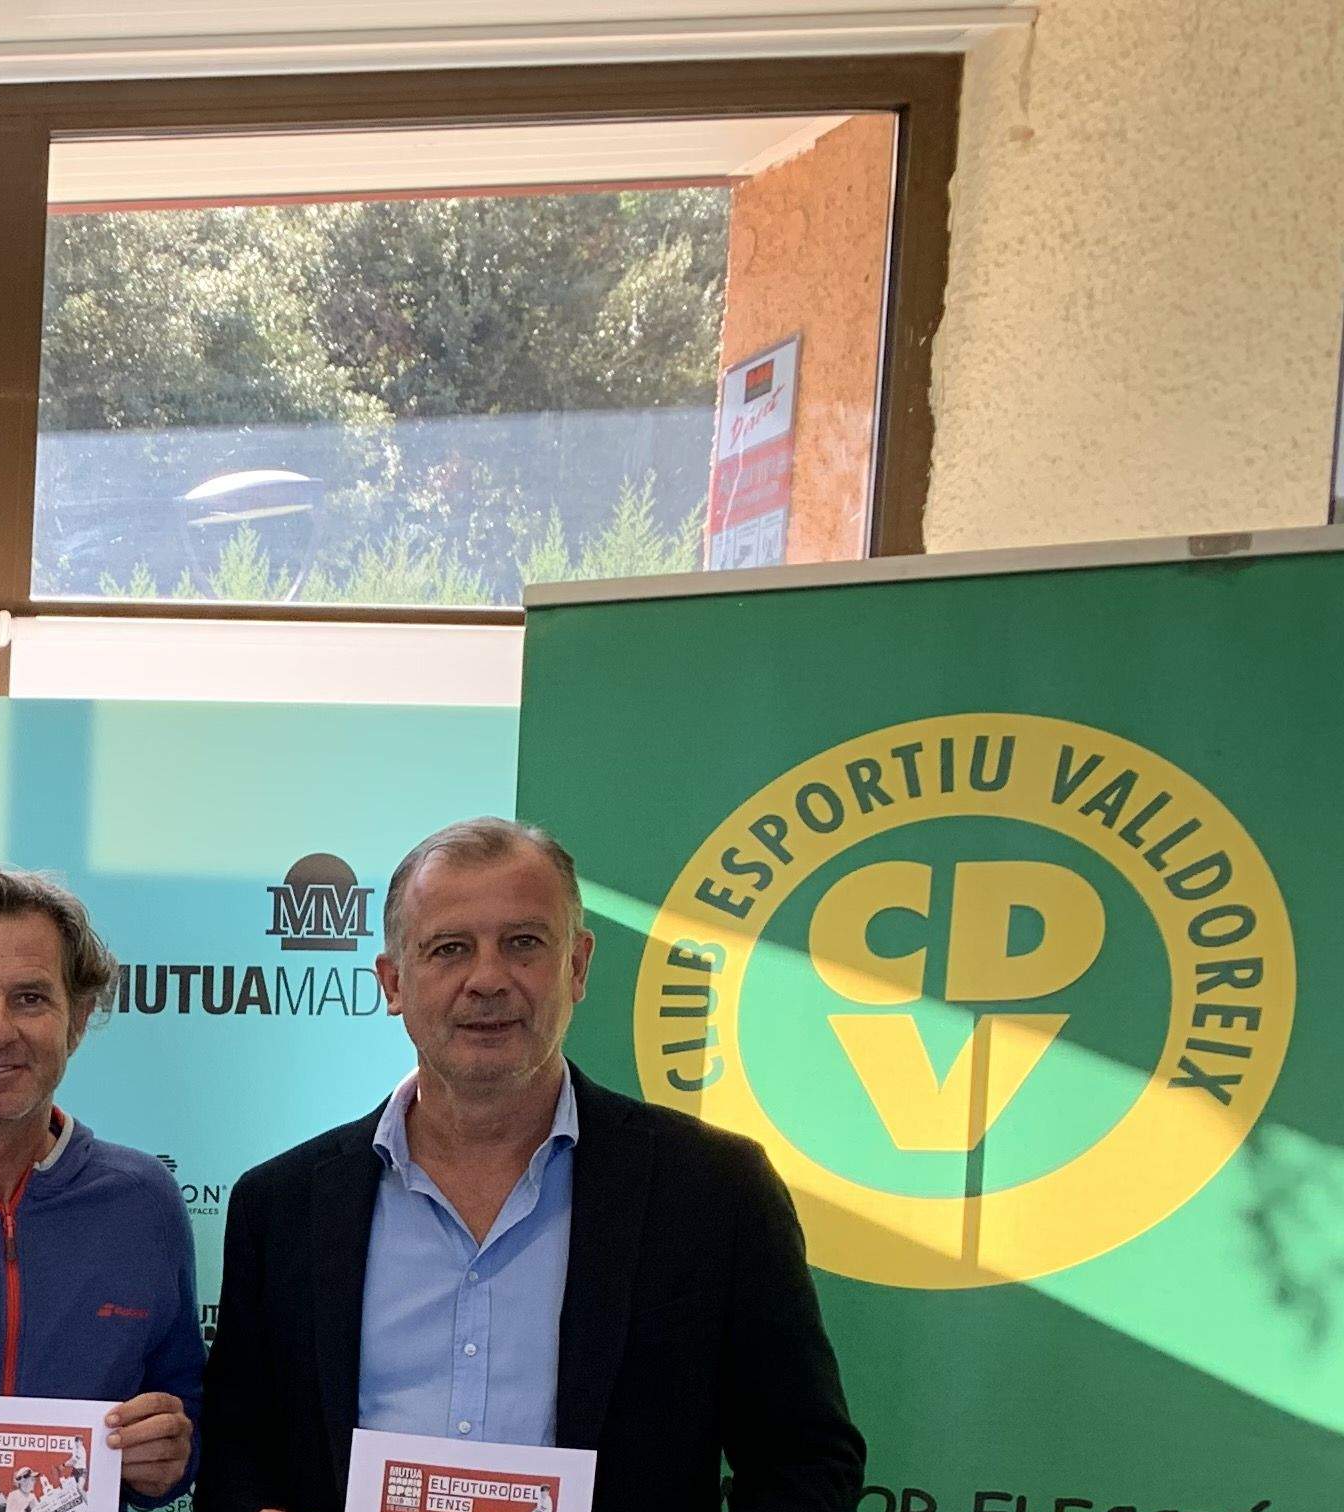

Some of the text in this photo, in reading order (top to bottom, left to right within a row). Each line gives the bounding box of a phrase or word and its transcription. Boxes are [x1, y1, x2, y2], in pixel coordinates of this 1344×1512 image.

[659, 735, 1264, 1106] CLUB ESPORTIU VALLDOREIX
[50, 1438, 74, 1450] DEL
[430, 1478, 540, 1501] EL FUTURO DEL
[428, 1498, 472, 1512] TENIS
